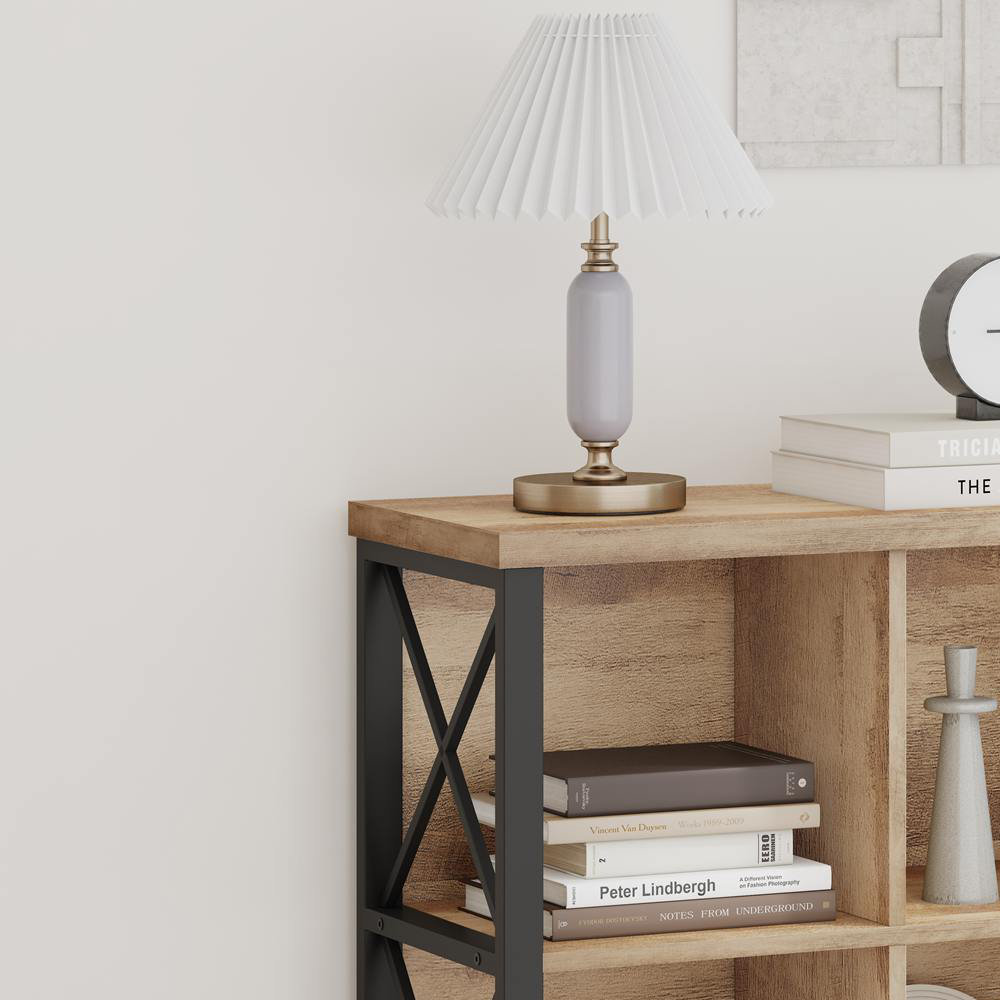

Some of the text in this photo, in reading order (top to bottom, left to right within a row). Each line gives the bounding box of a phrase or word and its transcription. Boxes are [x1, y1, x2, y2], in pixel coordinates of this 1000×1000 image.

[957, 478, 991, 495] THE
[590, 826, 620, 835] Vincent
[621, 823, 637, 833] Van
[638, 823, 667, 833] Duysen
[761, 834, 770, 863] EERO
[599, 878, 716, 900] Peter Lindbergh
[767, 879, 801, 888] Photography
[659, 902, 814, 921] NOTES FROM UNDERGROUND
